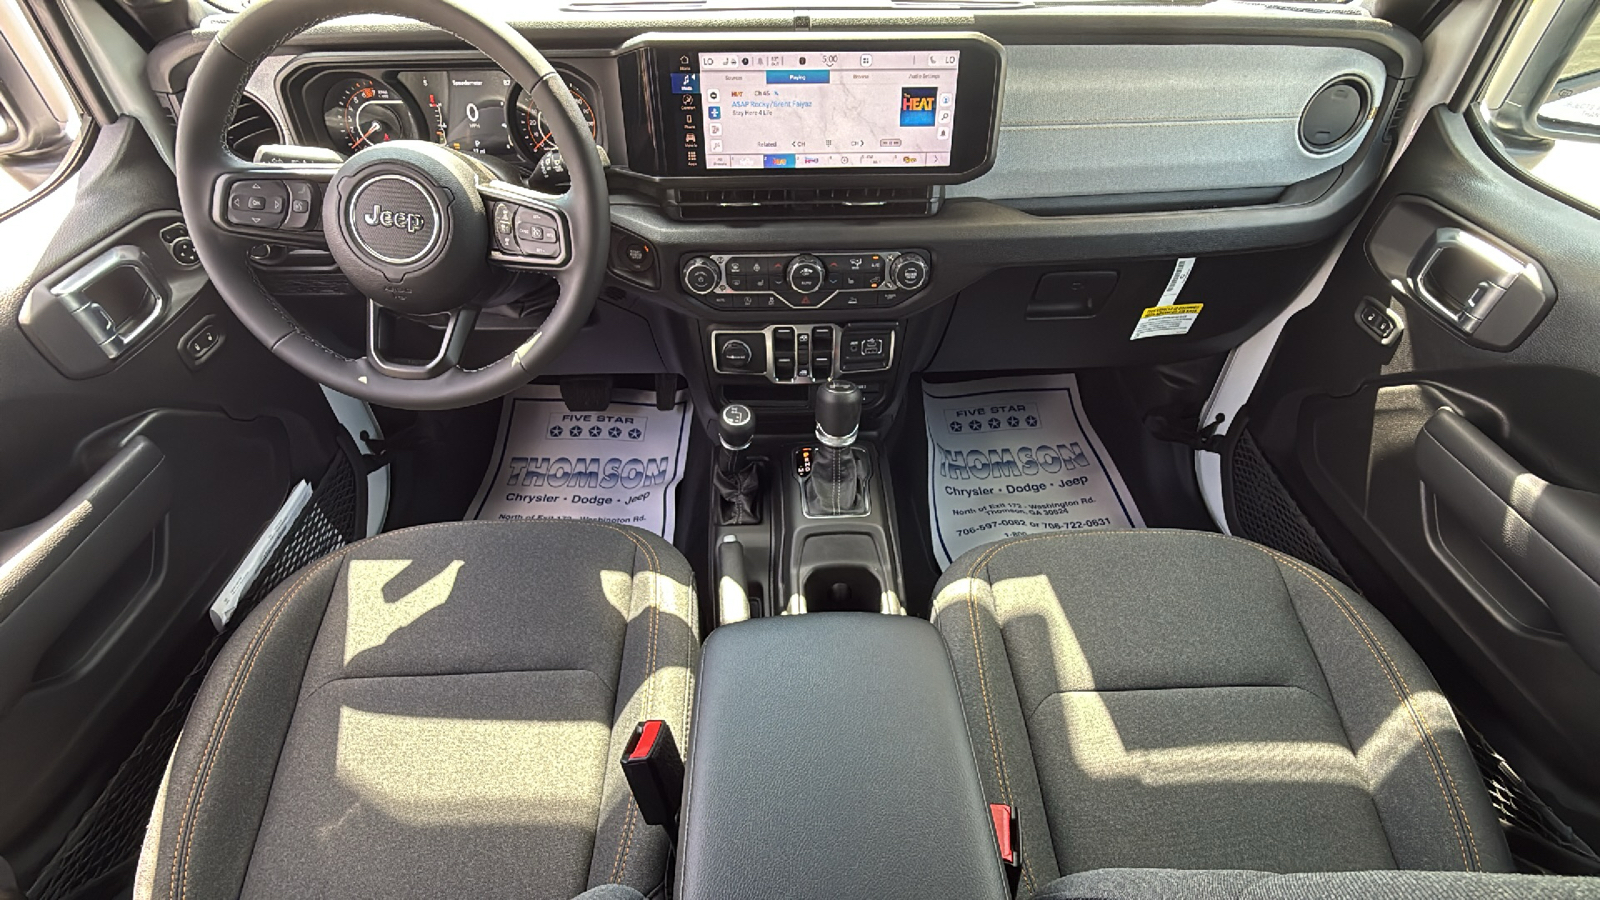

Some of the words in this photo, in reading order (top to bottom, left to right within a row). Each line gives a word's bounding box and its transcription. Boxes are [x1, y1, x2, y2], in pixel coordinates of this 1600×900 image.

[466, 103, 479, 122] 0
[902, 97, 935, 111] HEAT
[364, 204, 425, 234] Jeep
[561, 414, 592, 423] FIVE
[596, 415, 634, 425] STAR
[955, 407, 986, 418] FIVE
[990, 404, 1026, 415] STAR
[507, 456, 669, 490] THOMSON
[944, 485, 994, 498] Chrysler
[1006, 481, 1047, 494] Dodge
[1058, 475, 1089, 488] Jeep
[505, 492, 559, 505] Chrysler
[571, 494, 613, 506] Dodge
[624, 491, 651, 506] Jeep
[952, 508, 977, 516] North
[988, 502, 1006, 510] Exit
[1028, 499, 1079, 511] Washington
[1080, 496, 1097, 505] Rd.
[498, 513, 523, 521] North
[632, 514, 647, 523] Rd.
